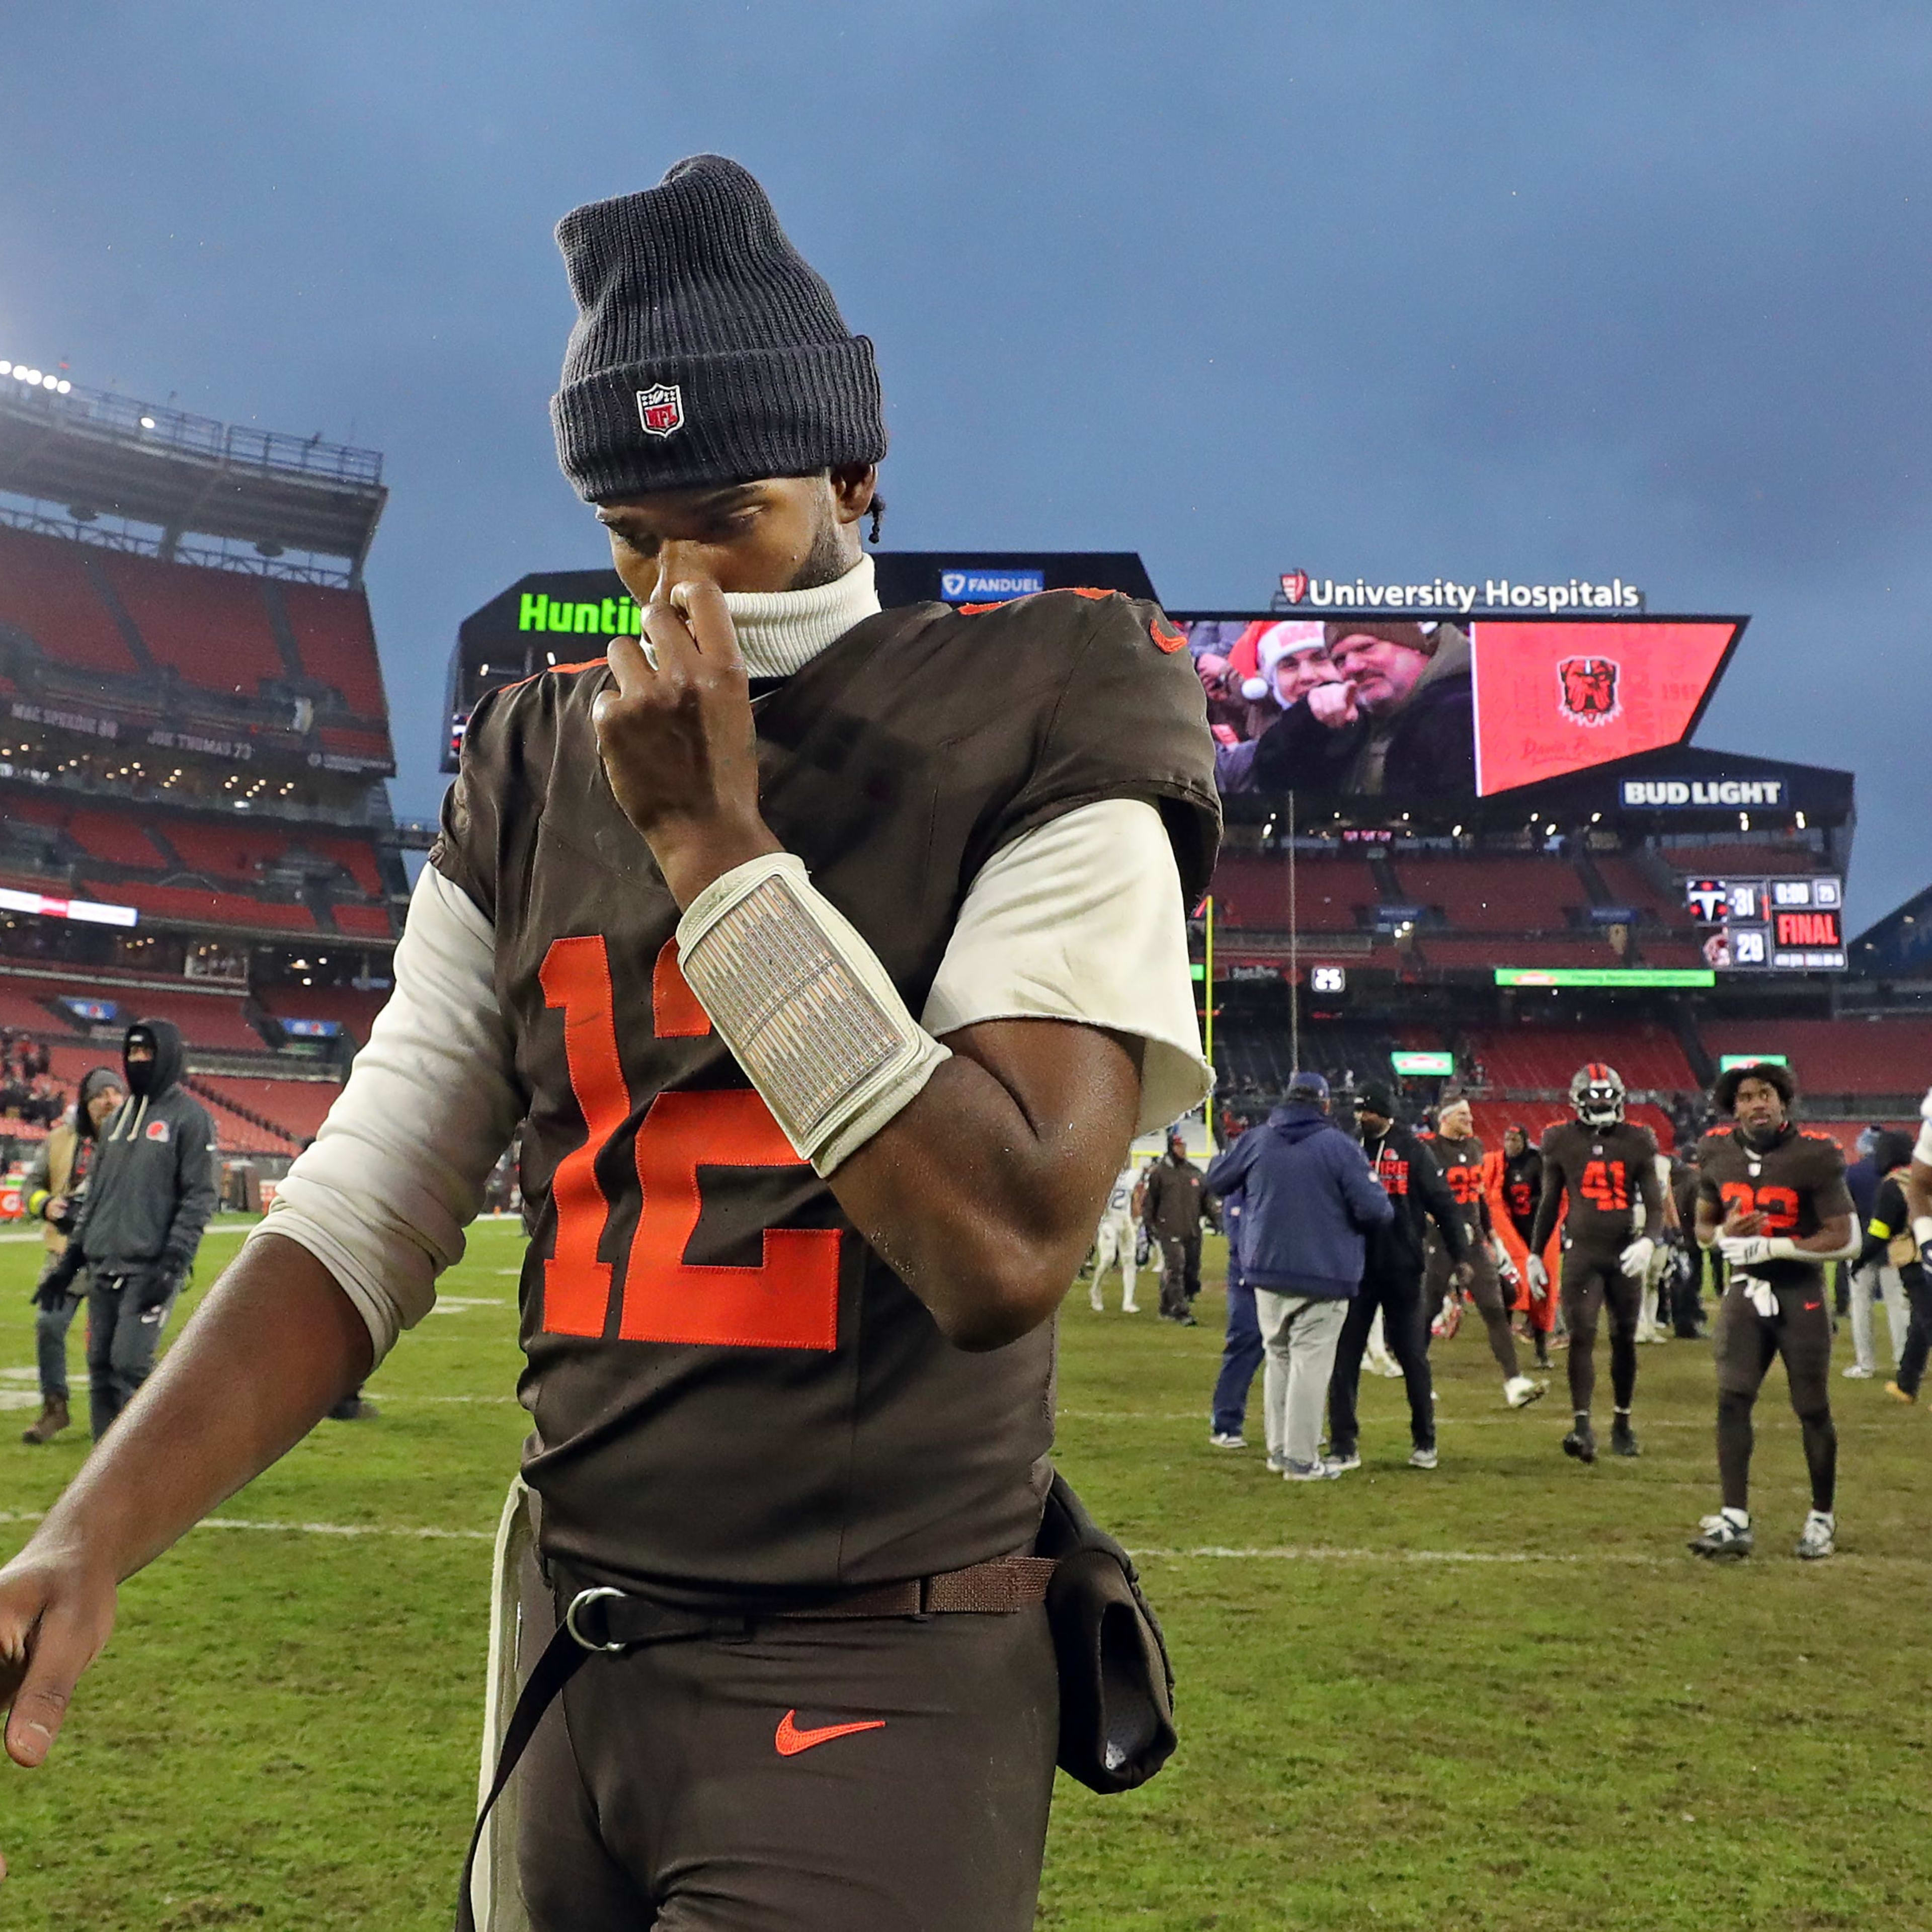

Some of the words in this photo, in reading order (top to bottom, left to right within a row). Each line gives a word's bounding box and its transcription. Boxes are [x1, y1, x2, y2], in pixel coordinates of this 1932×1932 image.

[968, 578, 1043, 593] FANDUEL
[1309, 579, 1476, 613] University
[1486, 579, 1639, 613] Hospitals
[1624, 781, 1690, 805] BUD
[1692, 781, 1781, 805] LIGHT
[1734, 887, 1754, 916] 31
[1778, 914, 1839, 945] FINAL
[538, 934, 843, 1351] 12
[1580, 1160, 1628, 1211] 41
